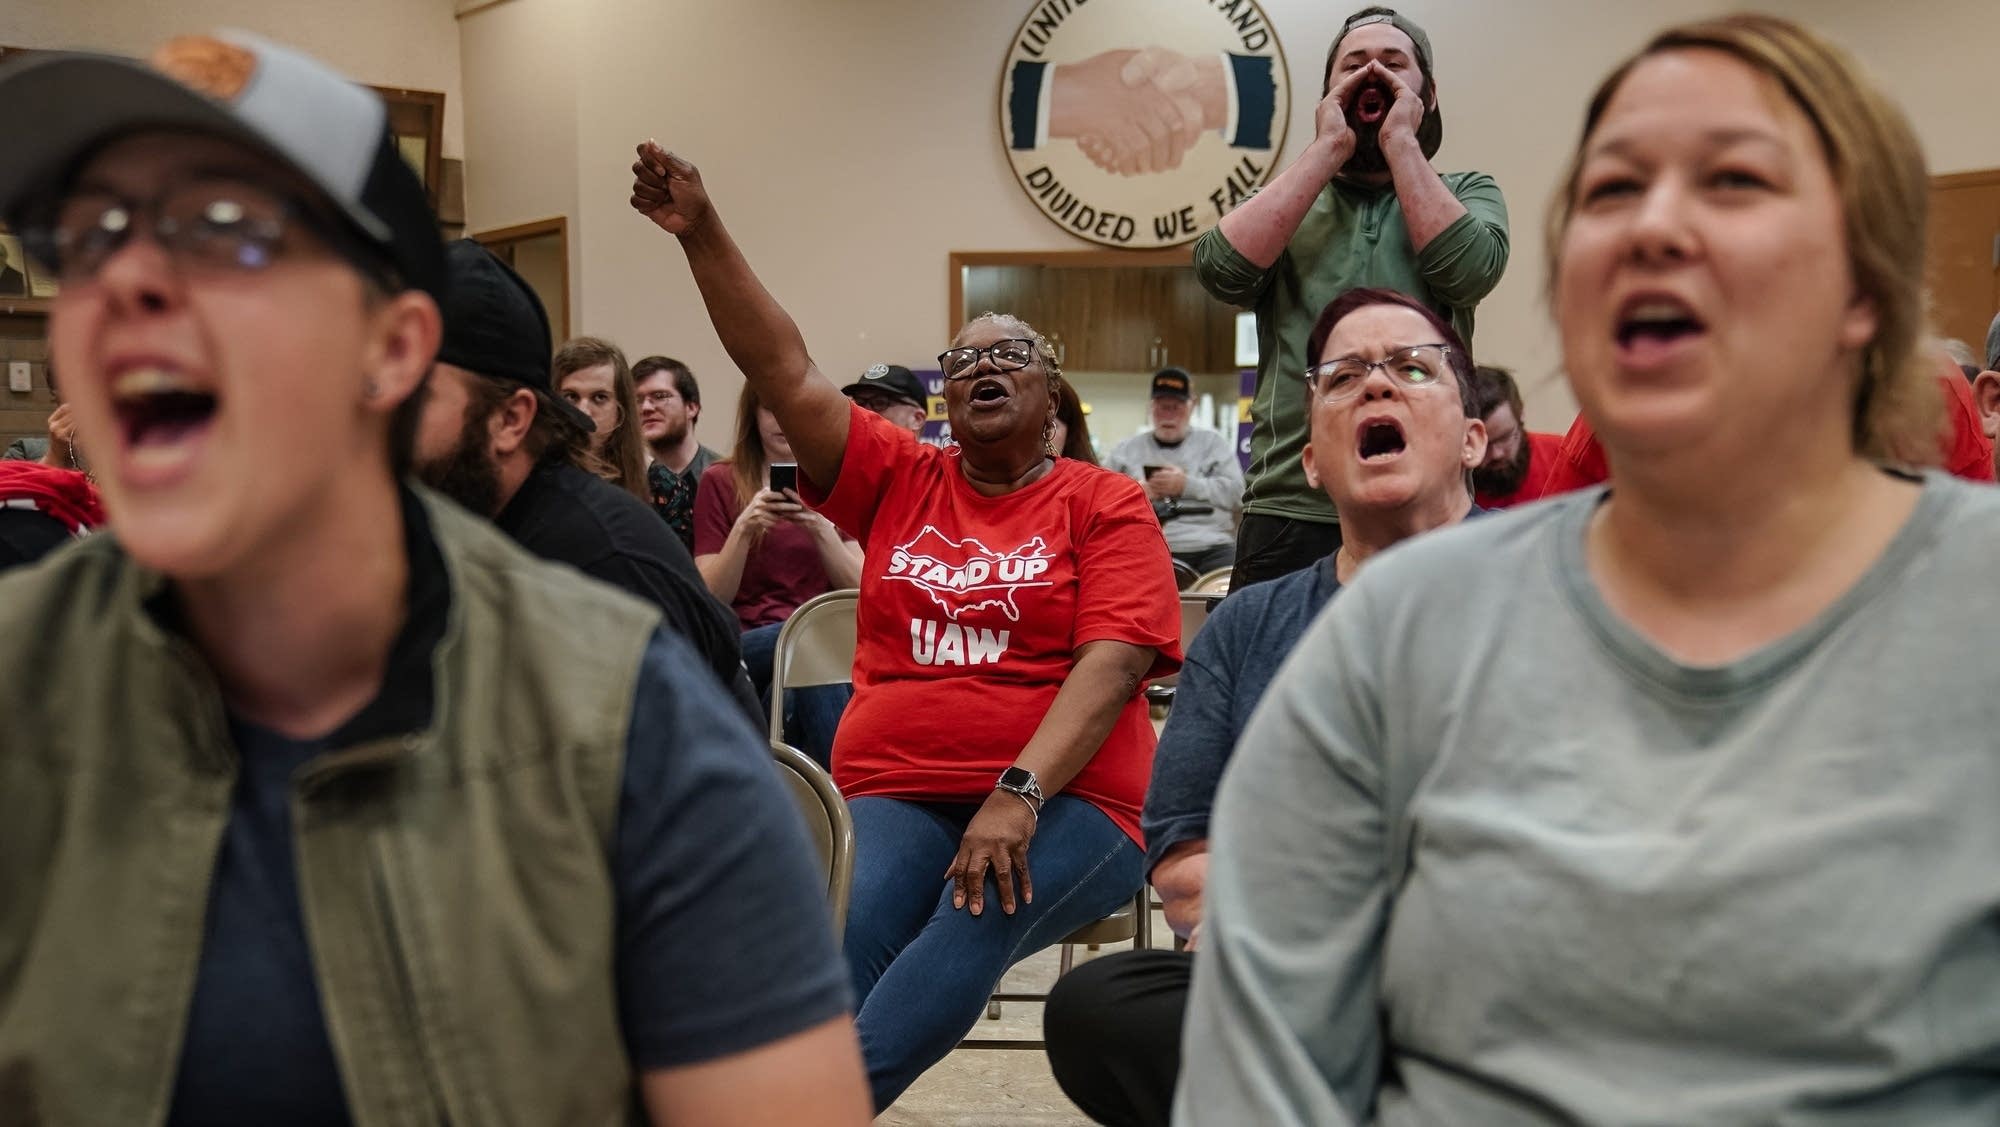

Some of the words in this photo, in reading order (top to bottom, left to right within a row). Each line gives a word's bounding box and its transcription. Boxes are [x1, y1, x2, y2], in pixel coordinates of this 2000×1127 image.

[1026, 166, 1134, 242] DIVIDED
[1155, 206, 1197, 240] WE
[1209, 156, 1263, 217] FALL
[888, 551, 990, 589] STAND
[998, 558, 1049, 582] UP
[911, 618, 1010, 666] UAW
